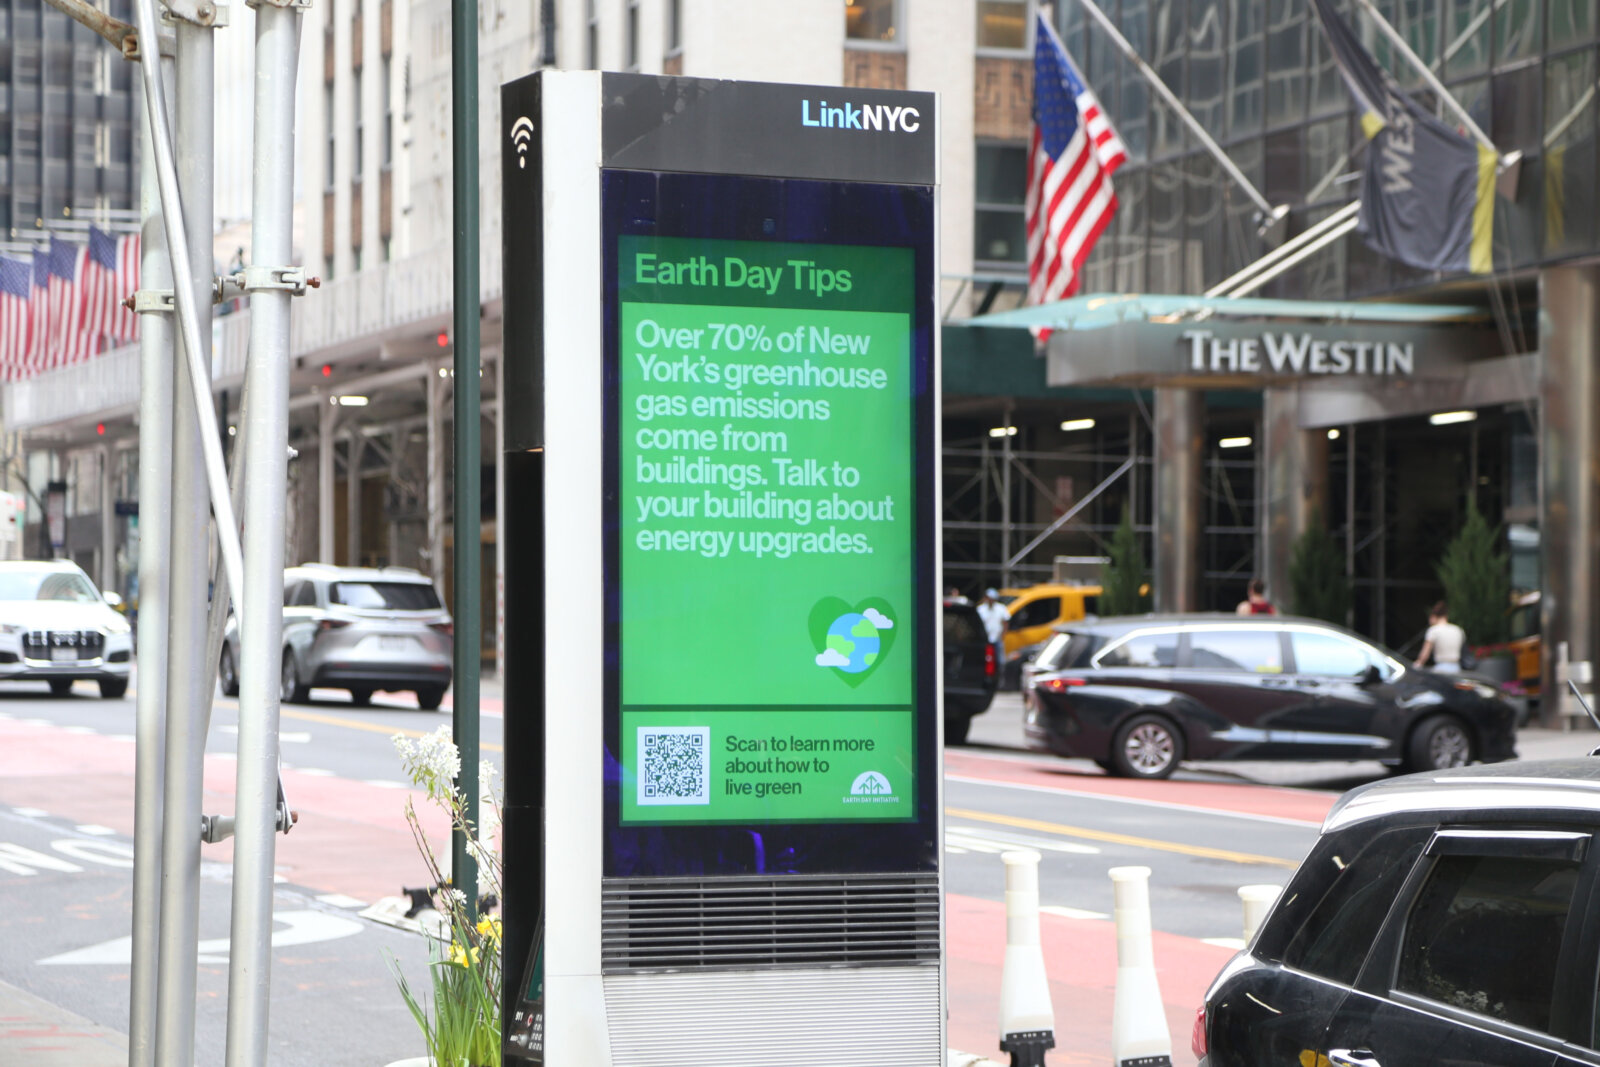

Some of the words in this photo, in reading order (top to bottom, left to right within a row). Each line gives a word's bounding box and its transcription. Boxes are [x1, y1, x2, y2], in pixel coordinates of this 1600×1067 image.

[802, 100, 920, 132] LinkNYC
[636, 253, 718, 287] Earth
[725, 257, 782, 295] Day
[788, 260, 852, 297] Tips
[636, 319, 704, 349] Over
[708, 323, 772, 352] 70%
[776, 326, 804, 353] of
[809, 327, 870, 355] New
[1183, 329, 1261, 373] THE
[1263, 331, 1414, 375] WESTIN
[636, 353, 720, 383] York’s
[724, 359, 887, 390] greenhouse
[636, 393, 687, 421] gas
[691, 391, 830, 420] emissions
[636, 428, 717, 450] come
[721, 424, 787, 452] from
[636, 455, 768, 490] buildings.
[772, 458, 828, 487] Talk
[832, 461, 859, 487] to
[636, 495, 700, 522] your
[704, 491, 812, 525] building
[816, 493, 894, 521] about
[636, 528, 734, 558] energy
[739, 526, 873, 558] upgrades.
[725, 736, 768, 752] Scan
[770, 737, 787, 752] to
[790, 736, 830, 752] learn
[832, 738, 874, 751] more
[725, 758, 773, 774] about
[776, 758, 810, 773] how
[813, 758, 830, 772] to
[725, 779, 752, 795] live
[755, 782, 802, 798] green
